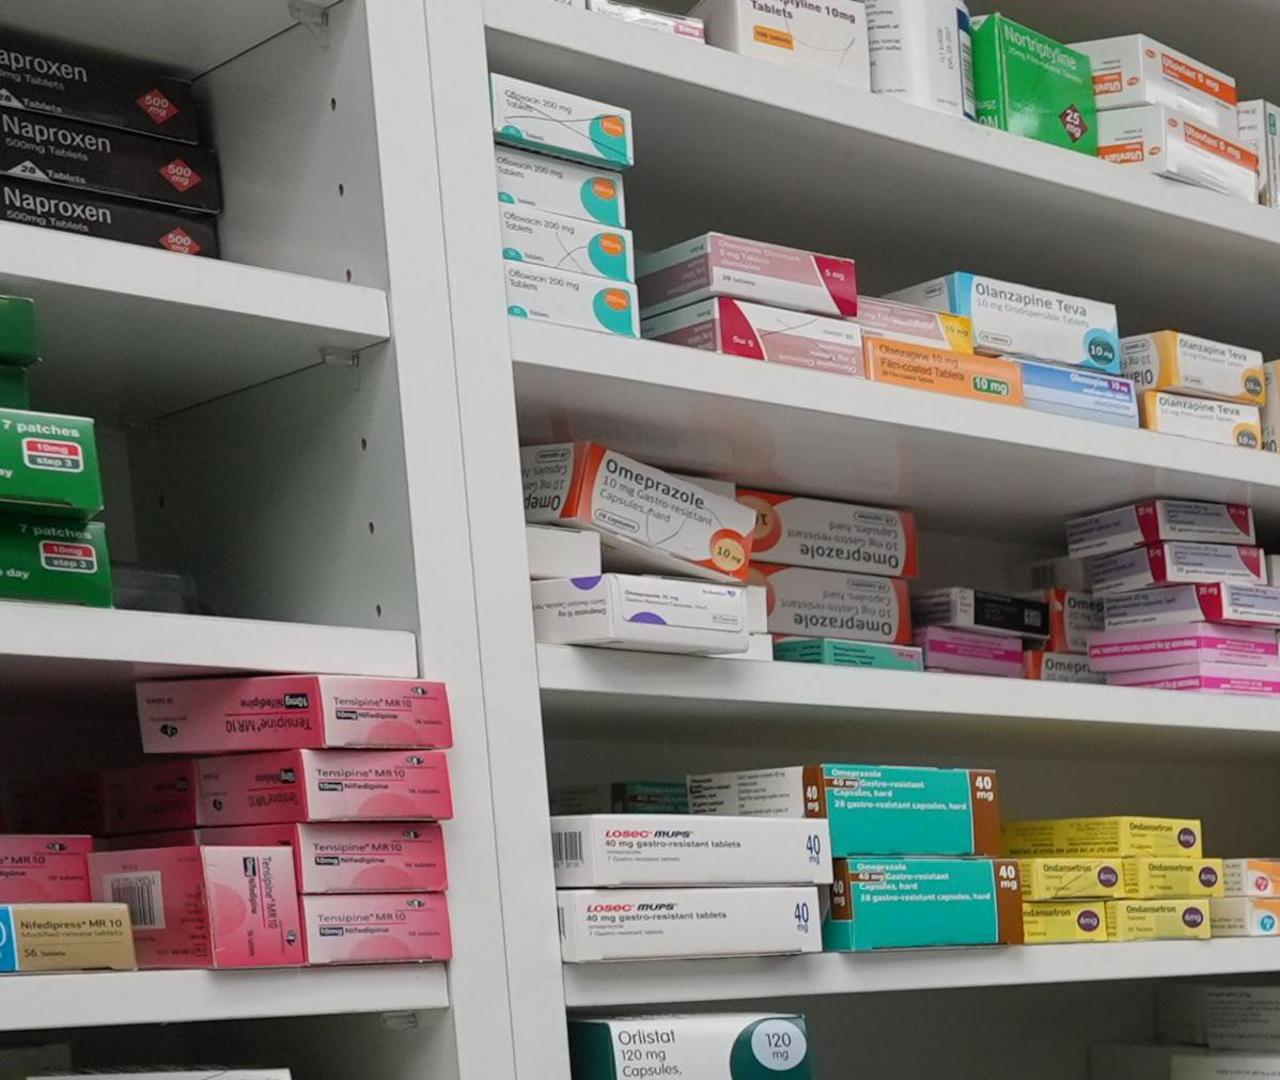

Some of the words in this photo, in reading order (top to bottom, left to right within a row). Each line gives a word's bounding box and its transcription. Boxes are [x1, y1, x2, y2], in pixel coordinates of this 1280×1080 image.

[825, 5, 856, 24] 10mg
[1005, 25, 1077, 71] Nortriptyline
[0, 49, 88, 82] aproxen
[145, 95, 169, 109] 500
[1066, 109, 1080, 125] 25
[2, 114, 111, 153] Naproxen
[6, 138, 46, 154] 500mg
[50, 146, 88, 162] Tablets
[167, 165, 192, 178] 500
[3, 186, 112, 224] Naproxen
[7, 210, 46, 226] 500mg
[50, 218, 89, 232] Tablets
[167, 233, 191, 246] 500
[976, 282, 1052, 309] Olanzapine
[1056, 300, 1087, 316] Teva
[880, 343, 930, 362] Olanzapine
[1090, 344, 1102, 355] 10
[1179, 338, 1226, 355] Olanzapine
[1227, 347, 1248, 362] Teva
[880, 358, 933, 376] Film-coated
[934, 368, 965, 382] Tablets
[975, 377, 988, 390] 10
[990, 381, 1008, 396] mg
[1158, 397, 1215, 414] Olanzapine
[1217, 405, 1240, 416] Teva
[2, 420, 12, 430] 7
[16, 422, 80, 438] patches
[37, 443, 69, 454] 10mg
[36, 458, 62, 468] step
[64, 459, 72, 467] 3
[603, 476, 615, 488] 10
[606, 458, 705, 509] Omeprazole
[649, 508, 671, 523] hard
[20, 524, 27, 532] 7
[33, 527, 92, 540] patches
[716, 545, 729, 558] 10
[800, 544, 899, 569] Omeprazole
[53, 558, 77, 568] step
[6, 569, 30, 579] day
[793, 613, 892, 636] Omeprazole
[316, 768, 369, 779] Tensipine
[831, 769, 882, 779] Omeprazole
[860, 779, 925, 789] Gastro-resistant
[975, 776, 992, 789] 40
[806, 786, 818, 799] 40
[976, 790, 994, 801] mg
[845, 801, 911, 811] gastro-resistant
[1129, 822, 1173, 831] Ondansetron
[313, 843, 365, 853] Tensipine
[636, 840, 709, 849] gastro-resistant
[711, 840, 741, 848] tablets
[806, 835, 821, 856] 40
[998, 865, 1015, 879] 40
[1043, 863, 1092, 873] Ondansetron
[1148, 863, 1194, 872] Ondansetron
[884, 872, 950, 881] Gastro-resistant
[832, 881, 844, 893] 40
[1000, 879, 1017, 890] mg
[794, 903, 809, 924] 40
[1126, 905, 1177, 914] Ondansetron
[318, 913, 369, 923] Tensipine
[618, 912, 694, 923] gastro-resistant
[696, 911, 727, 919] tablets
[617, 1030, 676, 1045] Orlistat
[766, 1033, 791, 1048] 120
[621, 1050, 642, 1061] 120
[645, 1050, 666, 1063] mg
[772, 1048, 789, 1061] mg
[622, 1063, 682, 1079] Capsules,
